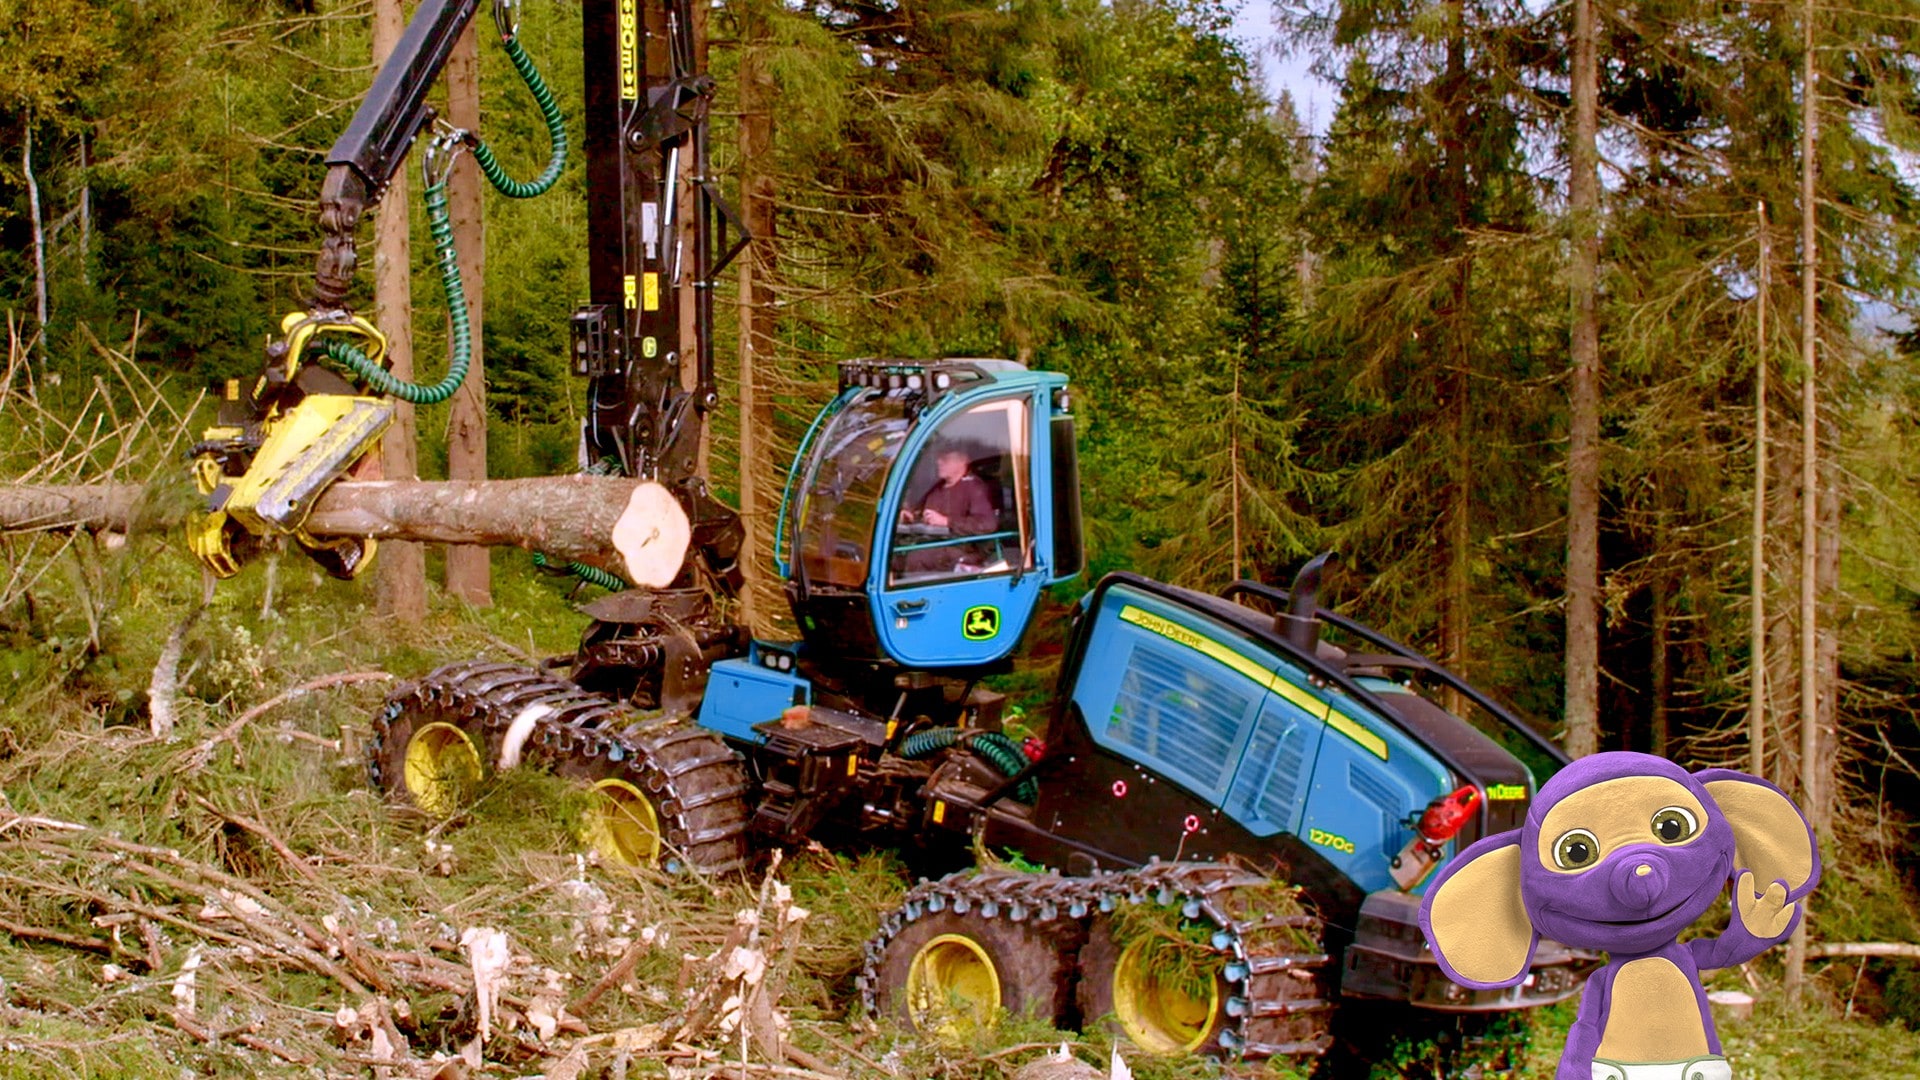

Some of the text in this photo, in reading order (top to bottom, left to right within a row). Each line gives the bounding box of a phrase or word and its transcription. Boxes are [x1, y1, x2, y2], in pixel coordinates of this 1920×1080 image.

[622, 13, 635, 69] 90m
[624, 275, 637, 309] IBC
[1135, 612, 1203, 648] JOHN DEERE
[1497, 784, 1525, 800] DEERE
[1310, 828, 1355, 854] 1270G
